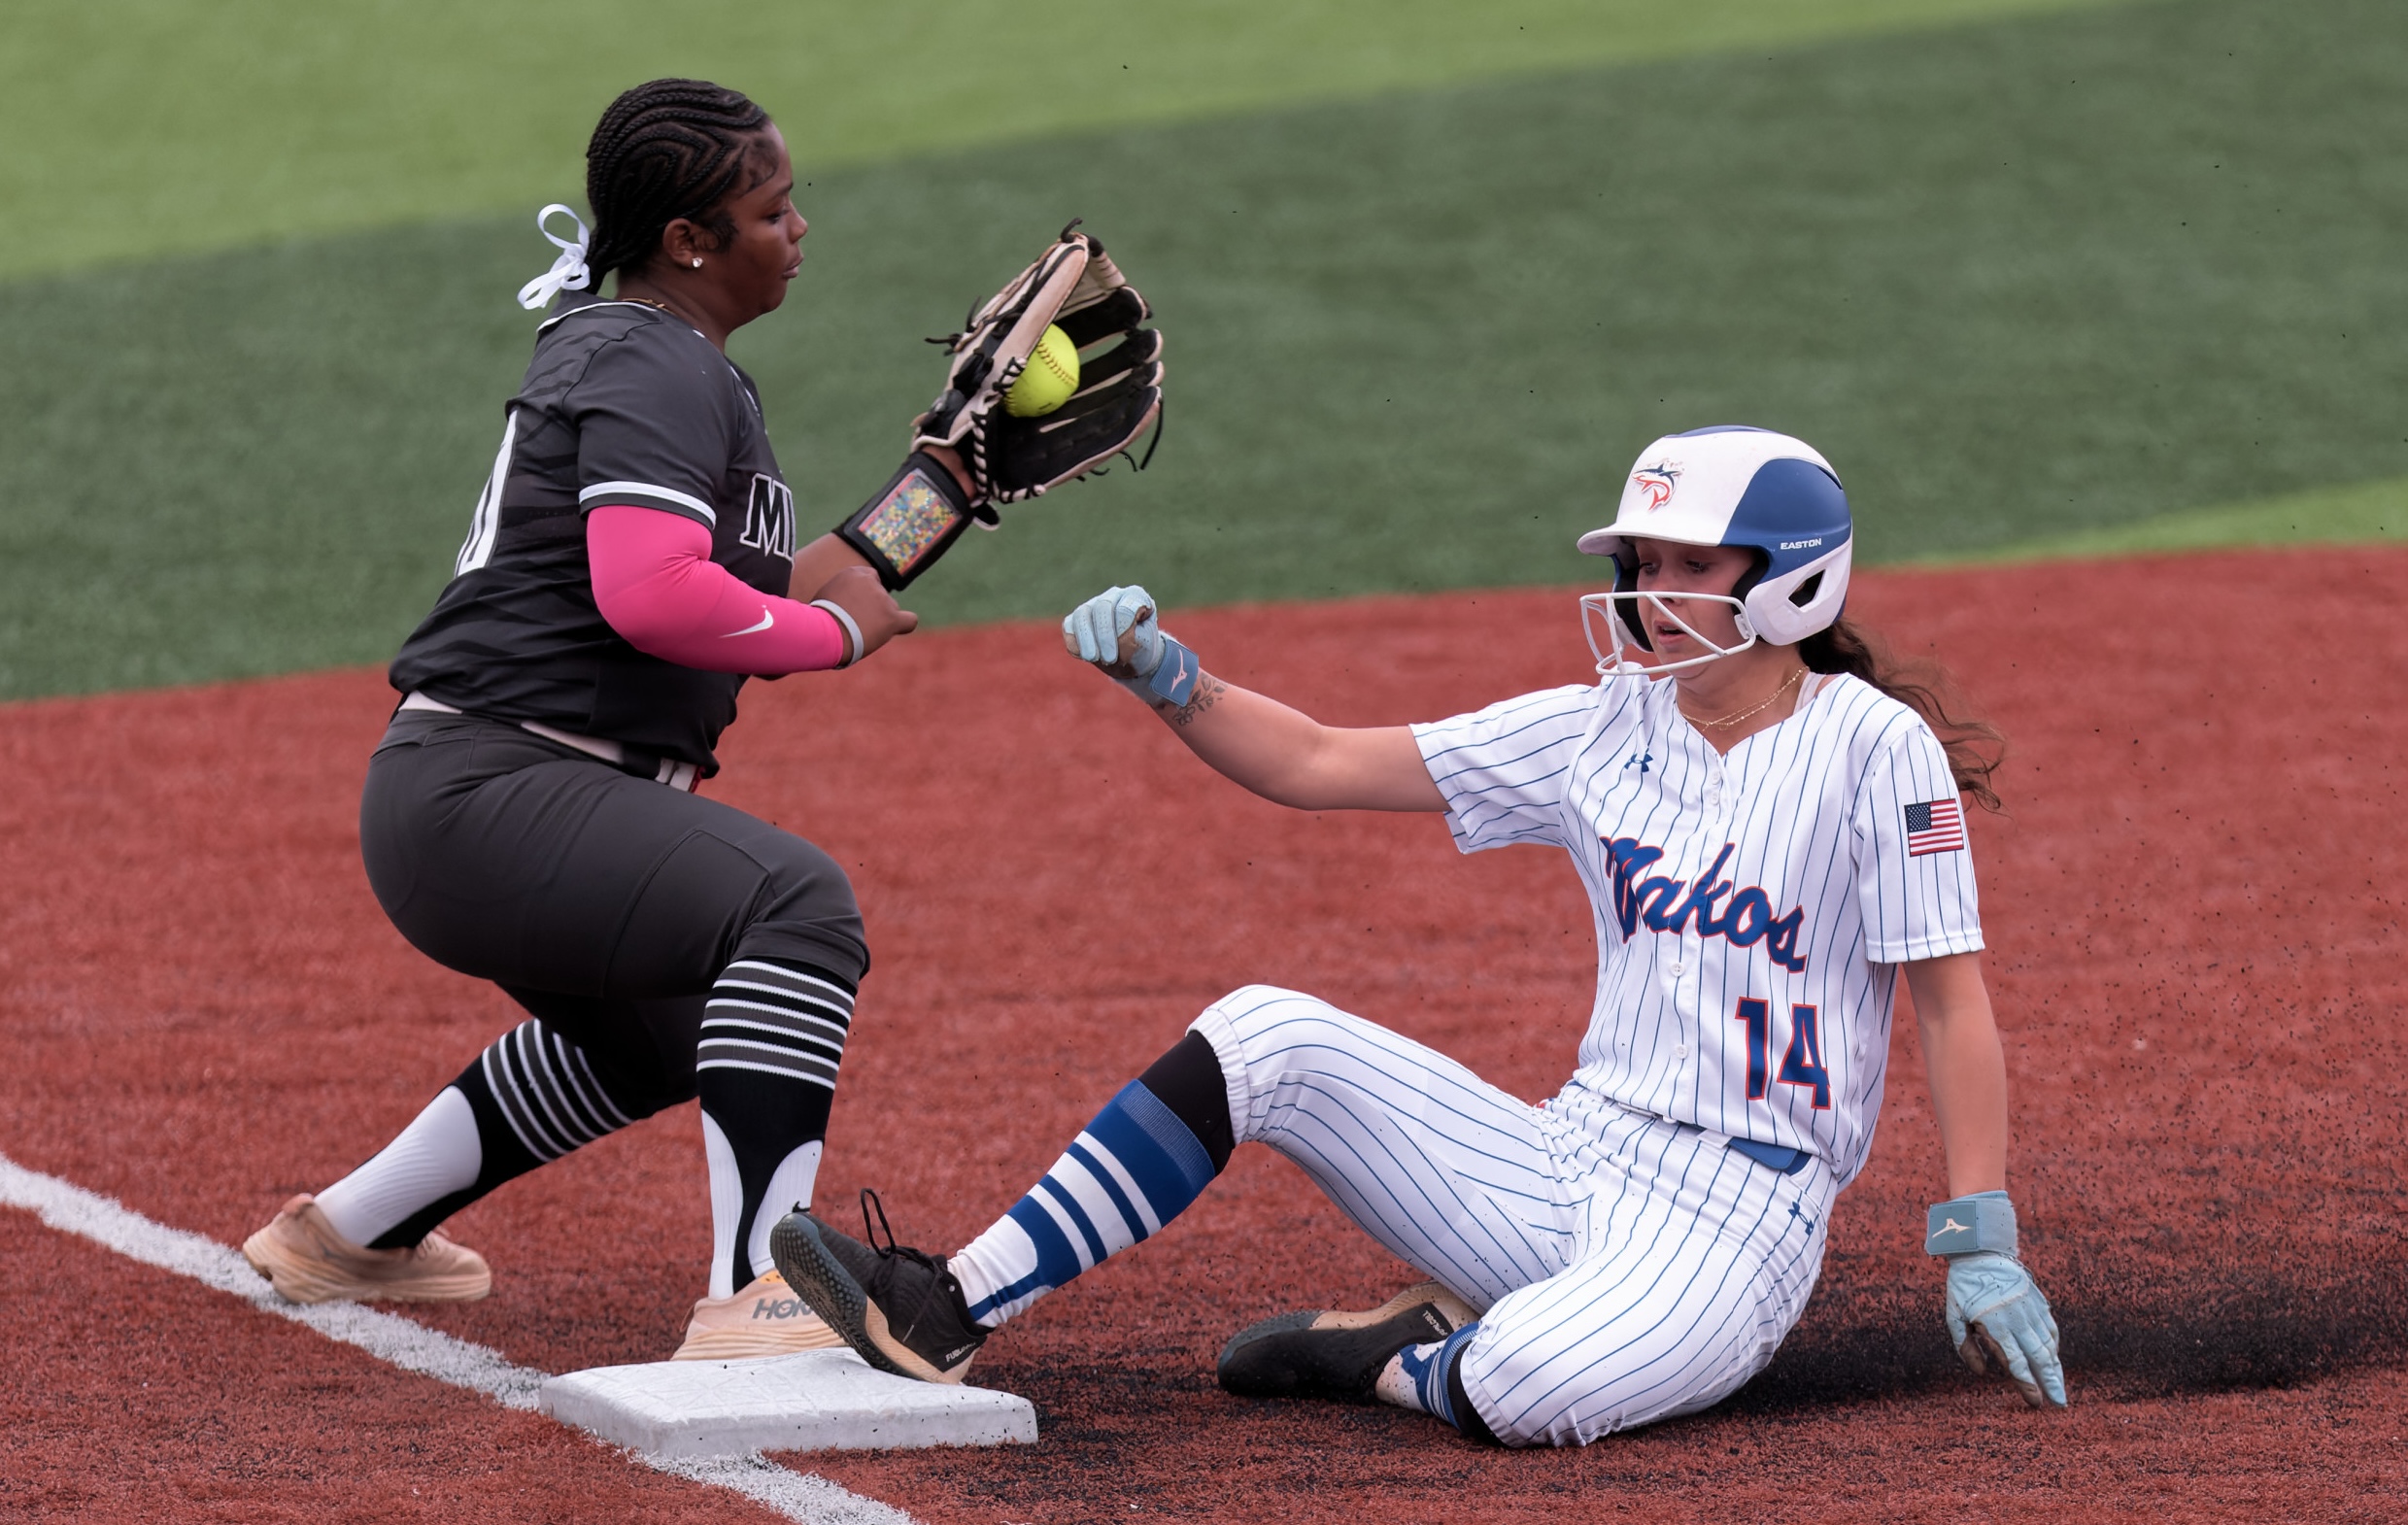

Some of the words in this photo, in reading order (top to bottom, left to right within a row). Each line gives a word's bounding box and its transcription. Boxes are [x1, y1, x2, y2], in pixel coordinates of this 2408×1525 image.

[1780, 537, 1822, 550] EASTON
[1599, 835, 1808, 974] Makos
[1735, 996, 1831, 1110] 14
